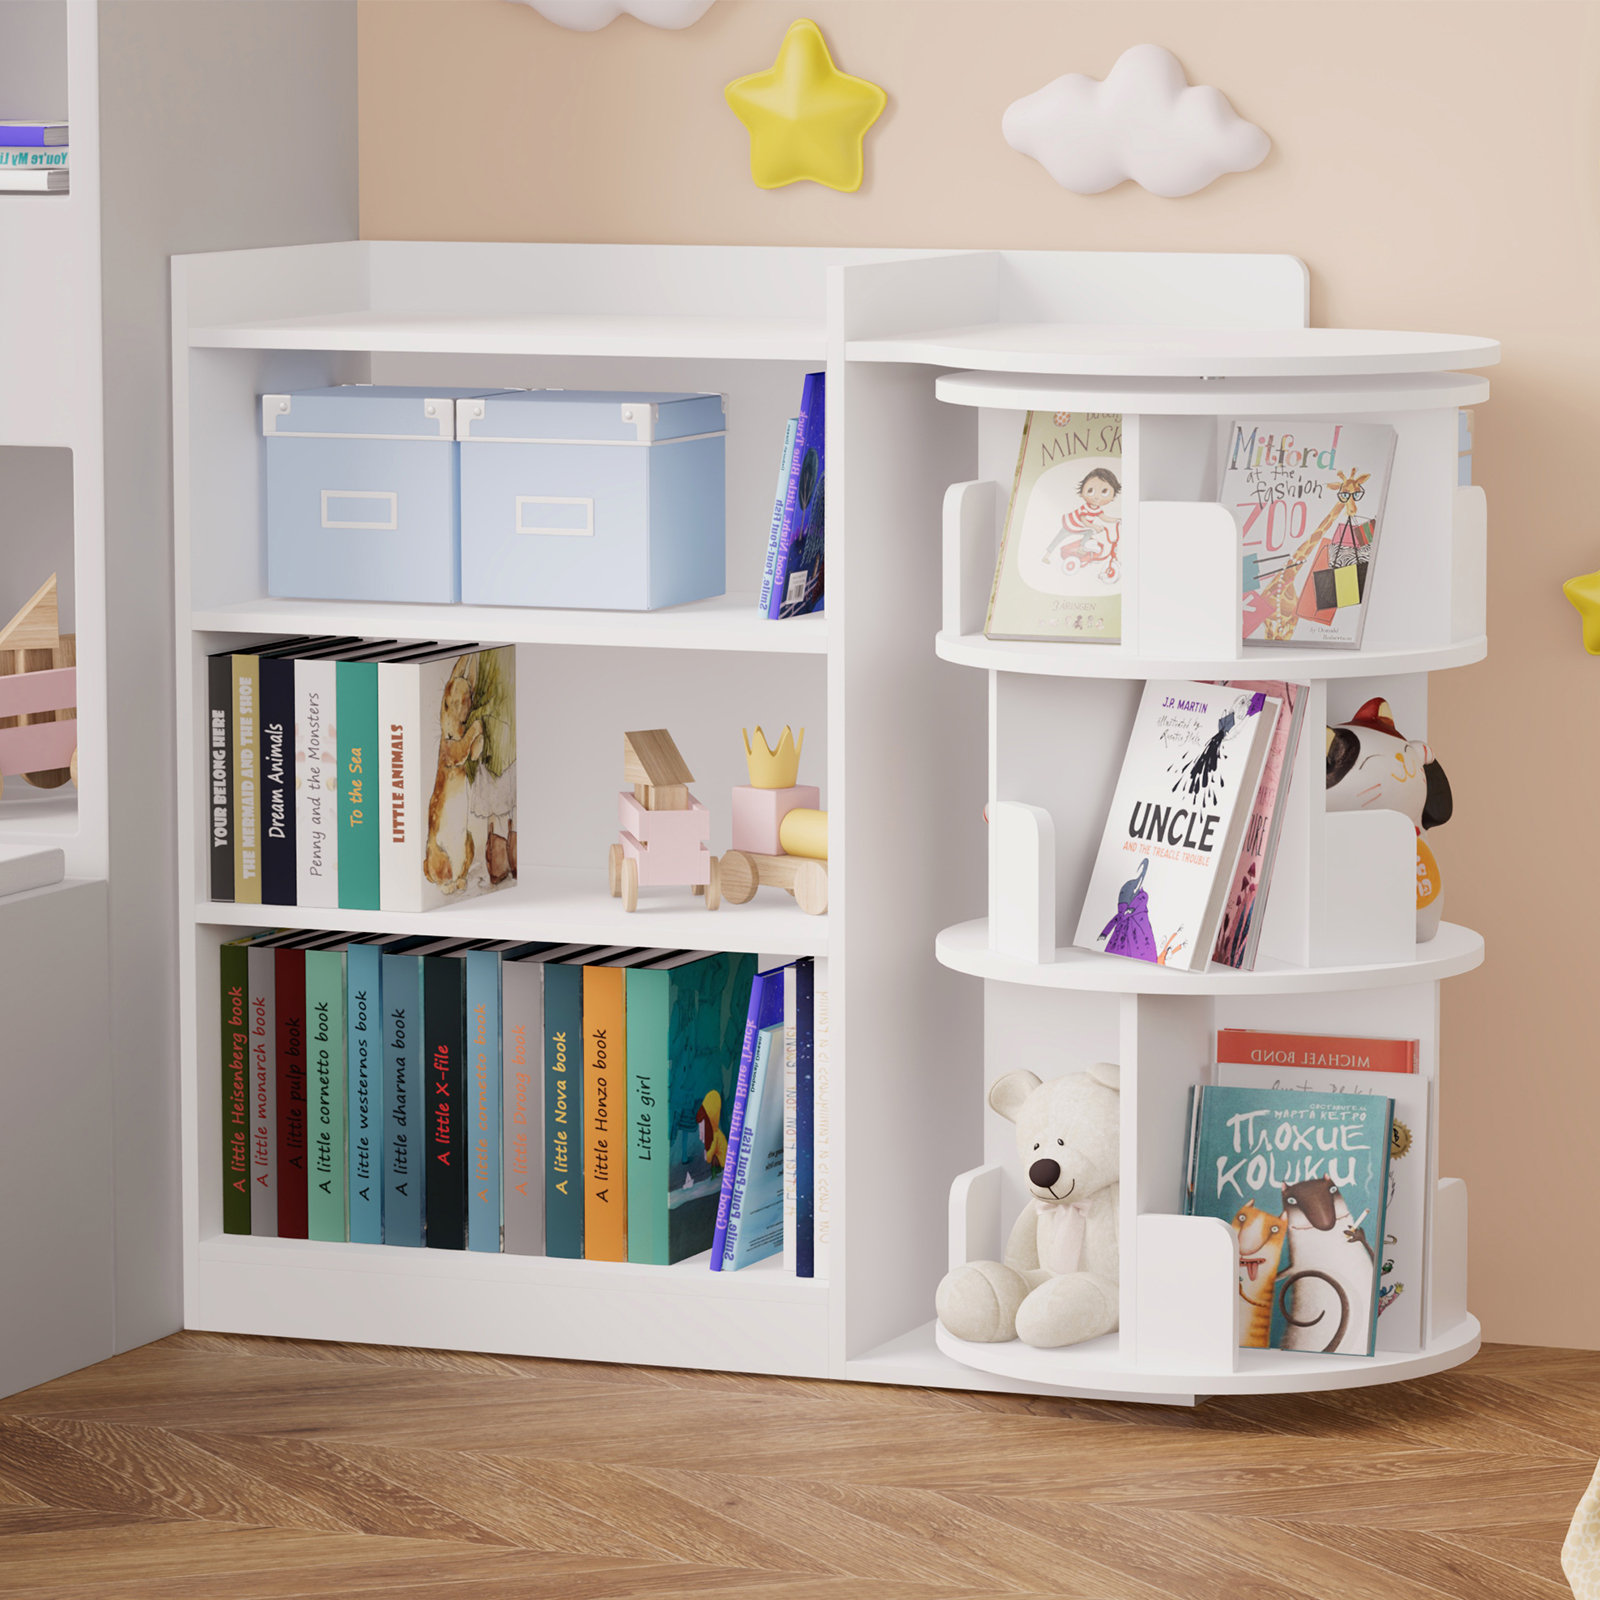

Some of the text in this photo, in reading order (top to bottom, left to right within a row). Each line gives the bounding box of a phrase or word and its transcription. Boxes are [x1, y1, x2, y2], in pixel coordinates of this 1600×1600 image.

[1042, 428, 1090, 466] MIN
[1229, 425, 1343, 470] Mitford
[1247, 466, 1295, 483] at the
[1250, 475, 1323, 510] fashion
[1236, 500, 1307, 552] ZOO
[1162, 697, 1208, 714] J.P. MARTIN
[212, 710, 228, 847] YOUR BELONG HERE
[239, 677, 256, 879] THE MERMAID AND THE SHOE
[264, 723, 286, 839] Dream Animals
[307, 693, 326, 877] Penny and the Monsters
[348, 747, 363, 828] To the Sea
[391, 724, 405, 843] LITTLE ANIMALS
[1129, 801, 1220, 852] UNCLE
[1122, 841, 1211, 867] AND THE TREACLE TROUBLE
[228, 986, 248, 1192] A little Heisenberg book
[252, 997, 269, 1187] A little monarch book
[285, 1017, 307, 1169] A little pulp book
[314, 1001, 331, 1194] A little cornetto book
[355, 990, 370, 1201] A little westernos book
[391, 1008, 408, 1196] A little dharma book
[433, 1044, 450, 1166] A little X-file
[473, 1003, 489, 1203] A little cornetto book
[511, 1024, 531, 1196] A little Droog book
[552, 1031, 569, 1195] A little Nova book
[592, 1028, 609, 1203] A little Honzo book
[636, 1075, 656, 1161] Little girl
[1274, 1110, 1367, 1122] МАРТА КЕТРО
